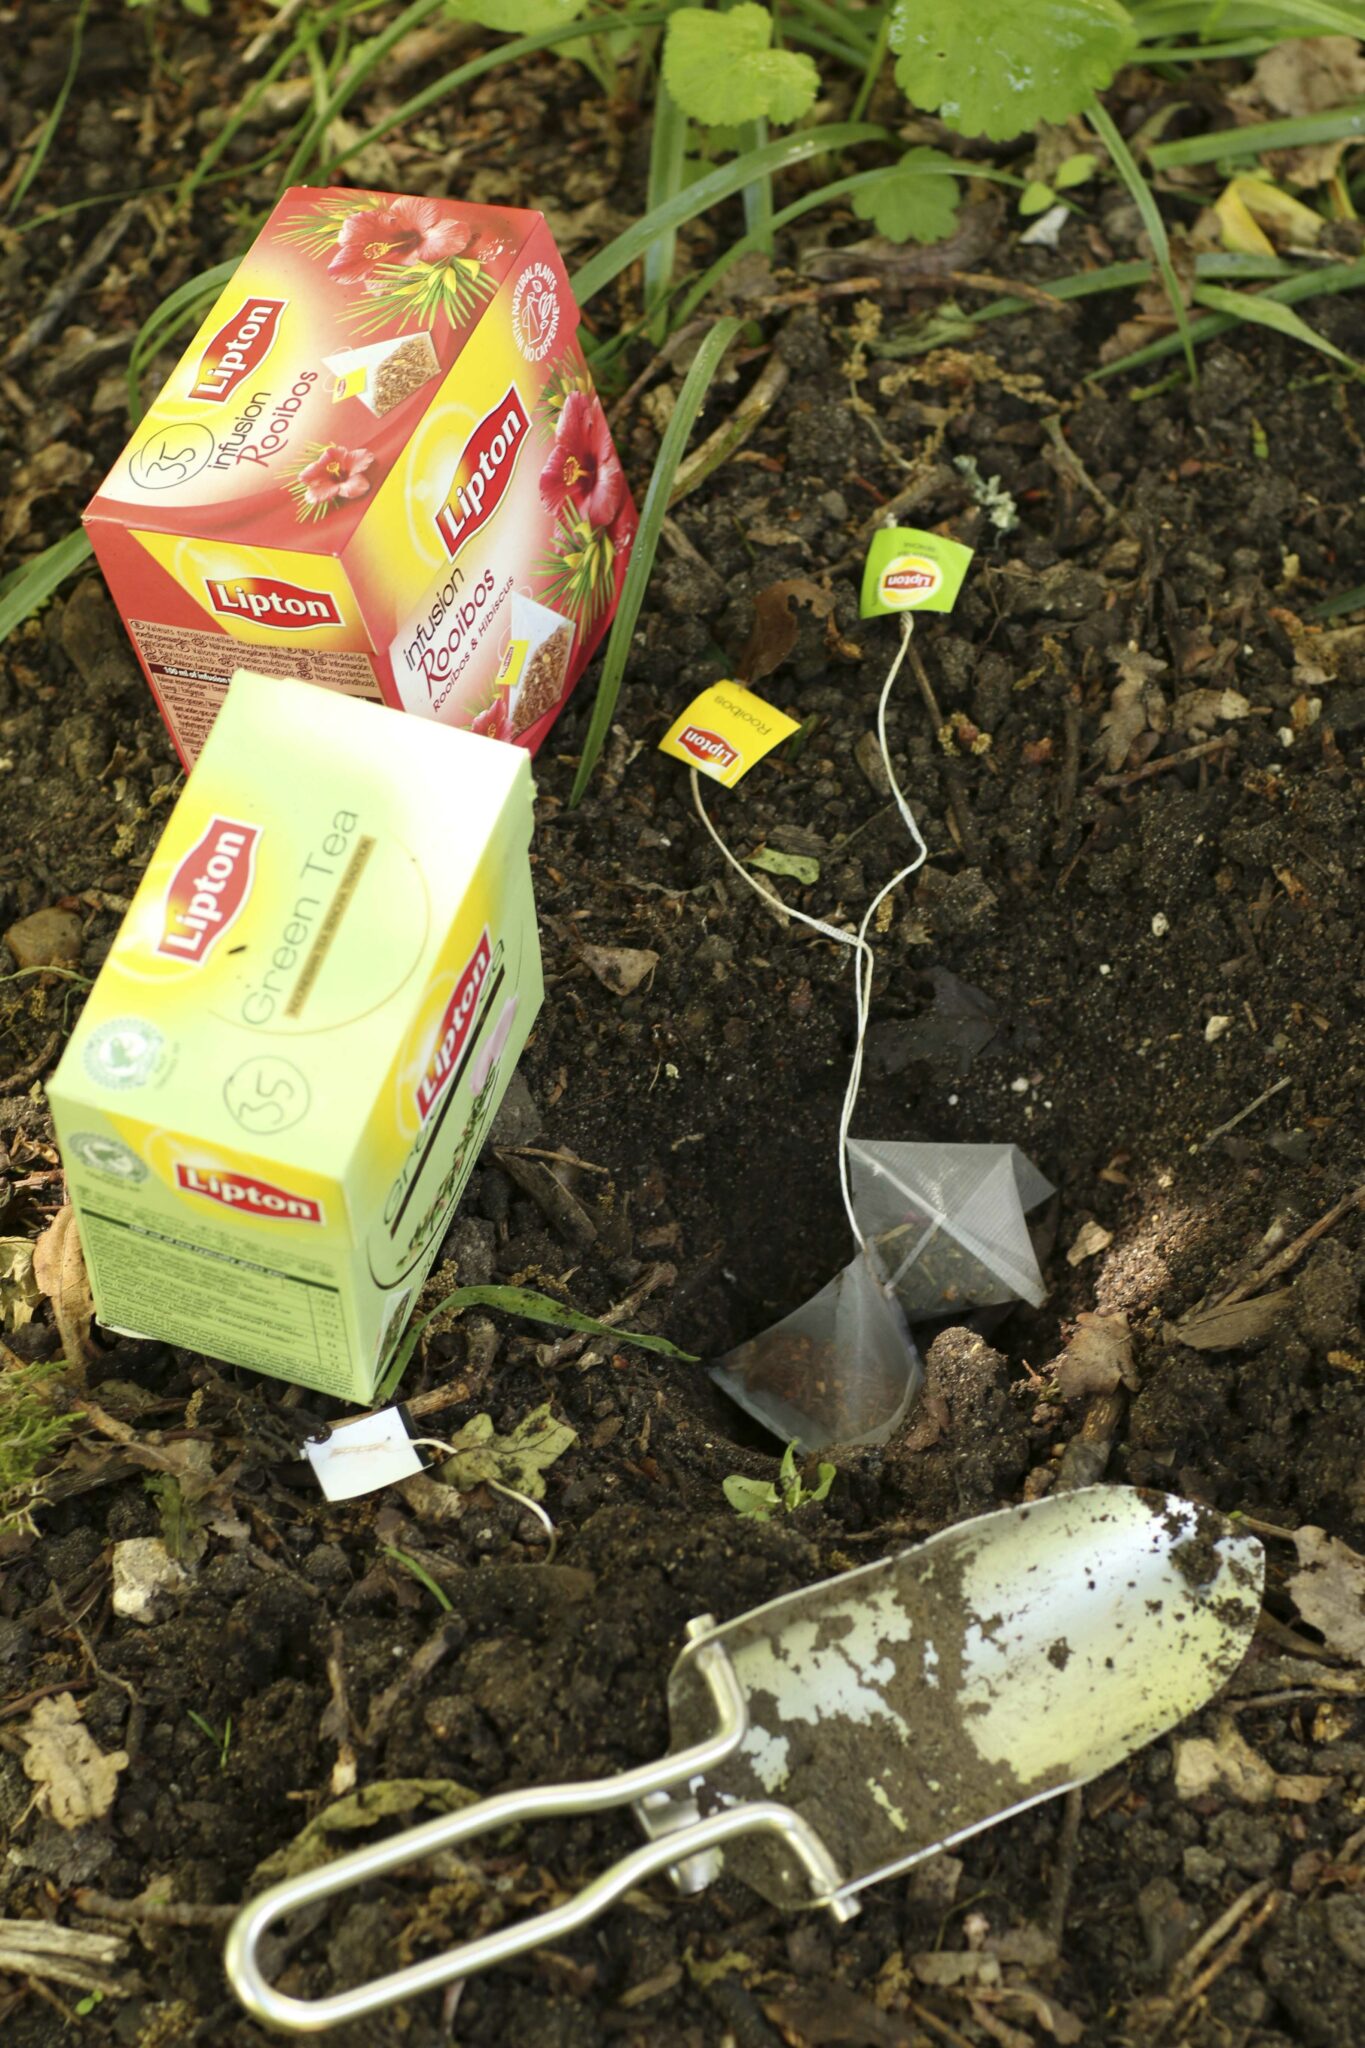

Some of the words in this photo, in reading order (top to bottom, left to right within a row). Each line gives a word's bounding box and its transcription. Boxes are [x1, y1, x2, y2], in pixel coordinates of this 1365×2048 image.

[511, 265, 534, 316] NATURAL
[534, 262, 558, 292] PLANTS
[196, 303, 271, 396] Lipton
[145, 441, 196, 480] 35
[207, 391, 272, 470] infusion
[236, 371, 319, 468] Rooibos
[441, 408, 523, 540] Lipton
[215, 584, 332, 618] Lipton
[403, 567, 465, 672] infusion
[887, 573, 932, 587] Lipton
[416, 568, 495, 699] Rooibos
[432, 651, 471, 713] Rooibos
[478, 575, 515, 638] Hibiscus
[683, 729, 737, 767] Lipton
[713, 694, 772, 737] Rooibos
[164, 830, 247, 954] Lipton
[240, 895, 321, 1027] Green
[300, 807, 360, 880] Tea
[419, 950, 487, 1103] Lipton
[238, 1069, 295, 1127] 35
[185, 1169, 314, 1220] Lipton
